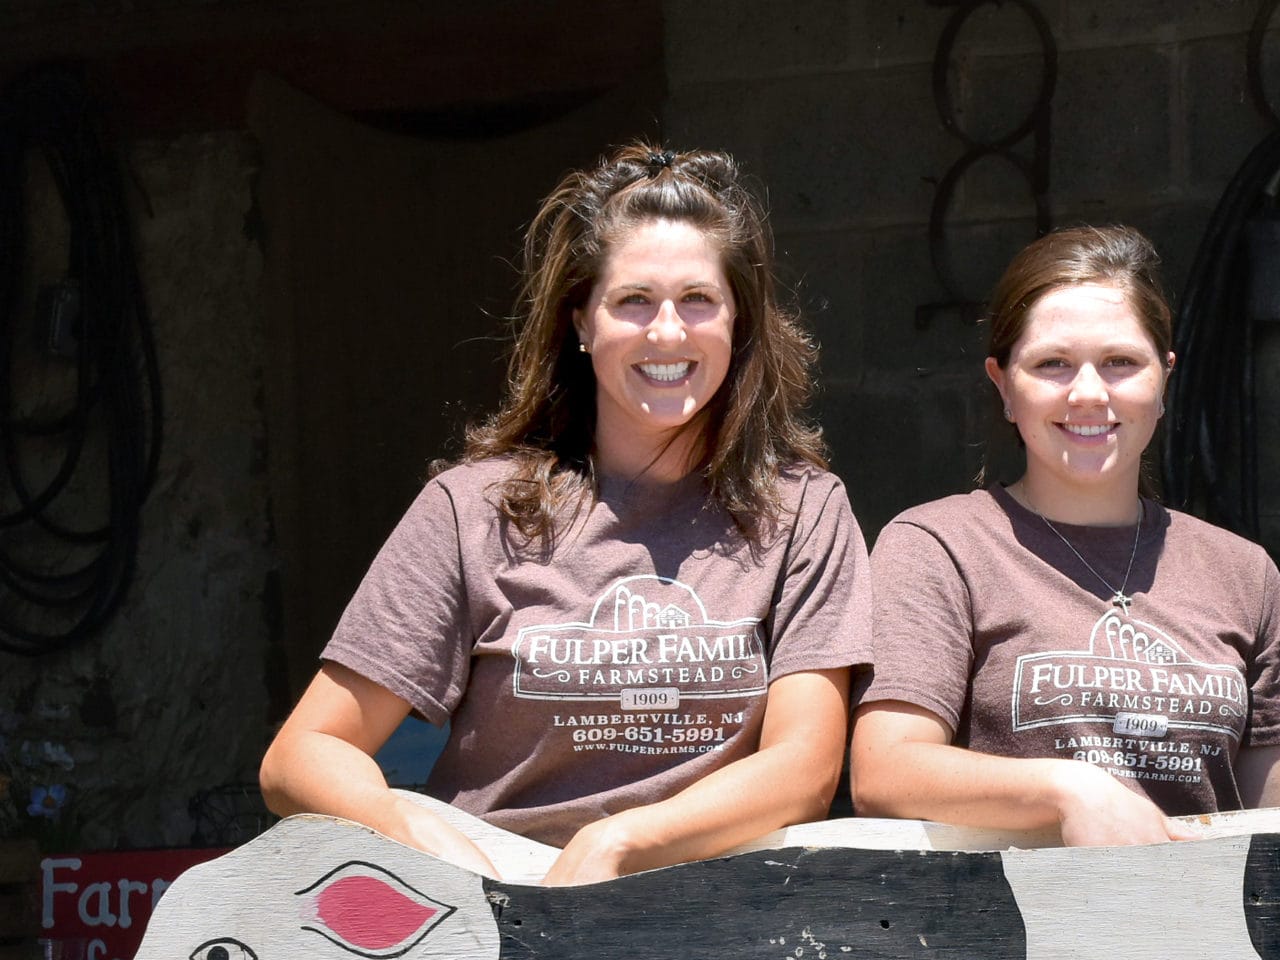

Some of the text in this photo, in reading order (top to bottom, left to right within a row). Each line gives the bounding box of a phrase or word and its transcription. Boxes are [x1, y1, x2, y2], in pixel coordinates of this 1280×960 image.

[527, 635, 653, 666] FULPER
[579, 666, 724, 685] FARMSTEAD
[1029, 664, 1243, 705] FULPER FAMILY
[632, 692, 668, 706] 1909
[1080, 692, 1213, 715] FARMSTEAD
[721, 712, 744, 724] NJ
[1125, 720, 1159, 732] 1909
[572, 727, 725, 743] 609-651-5991
[1199, 744, 1222, 757] NJ
